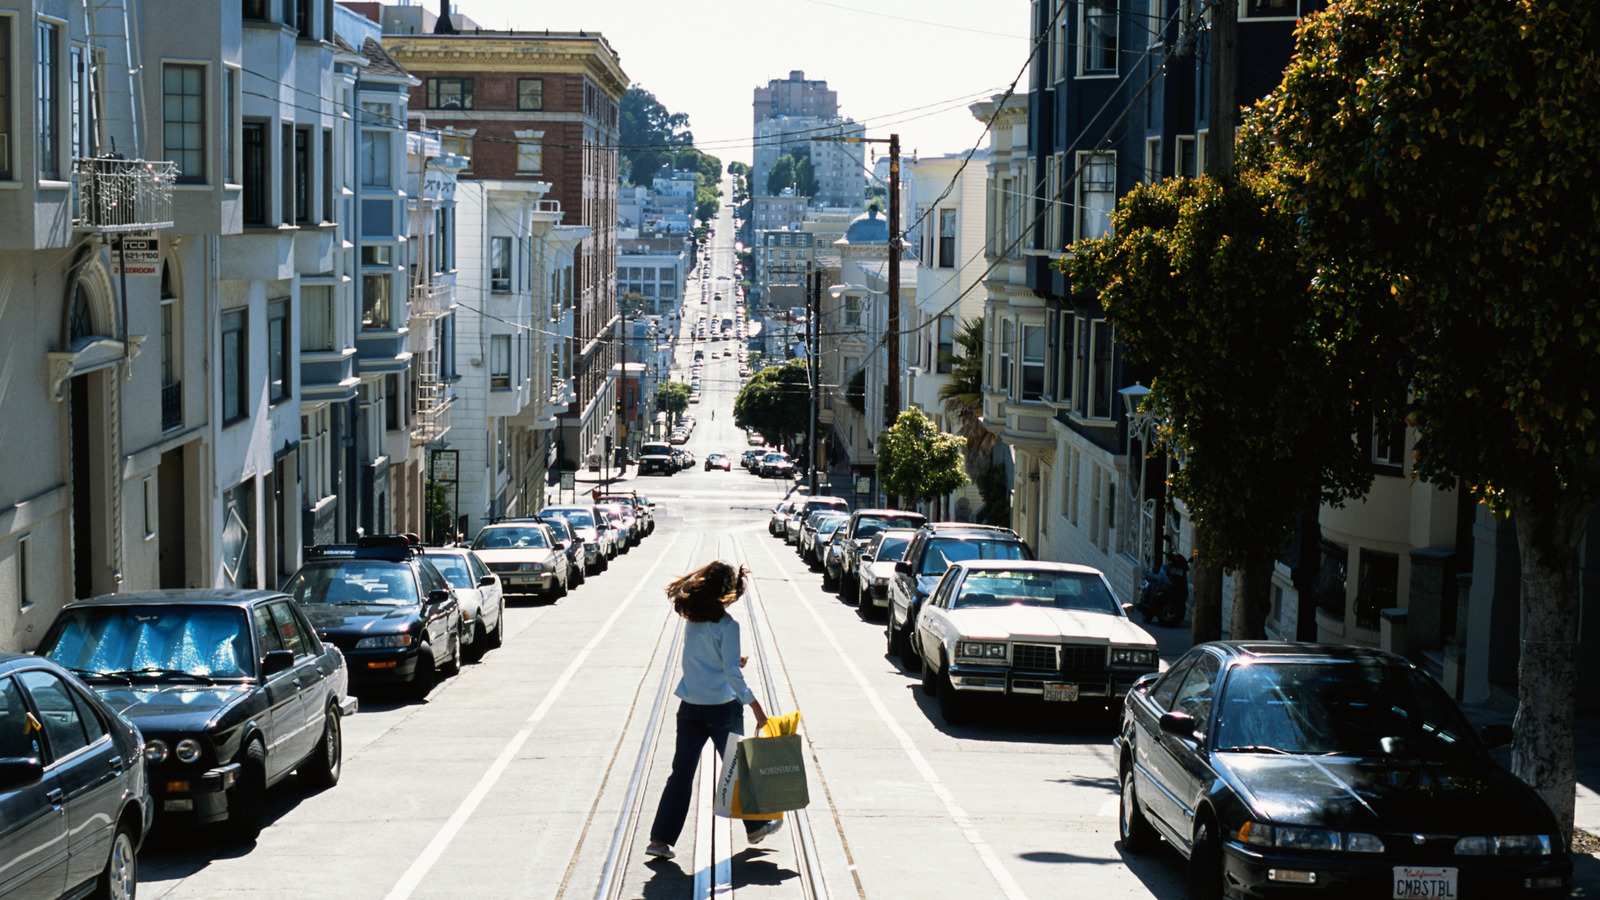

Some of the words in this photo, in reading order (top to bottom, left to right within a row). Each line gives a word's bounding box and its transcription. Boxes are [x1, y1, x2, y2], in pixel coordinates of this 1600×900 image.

[759, 765, 800, 776] NORDSTROM
[1406, 869, 1446, 880] California
[1397, 879, 1454, 897] CMBSTBL
